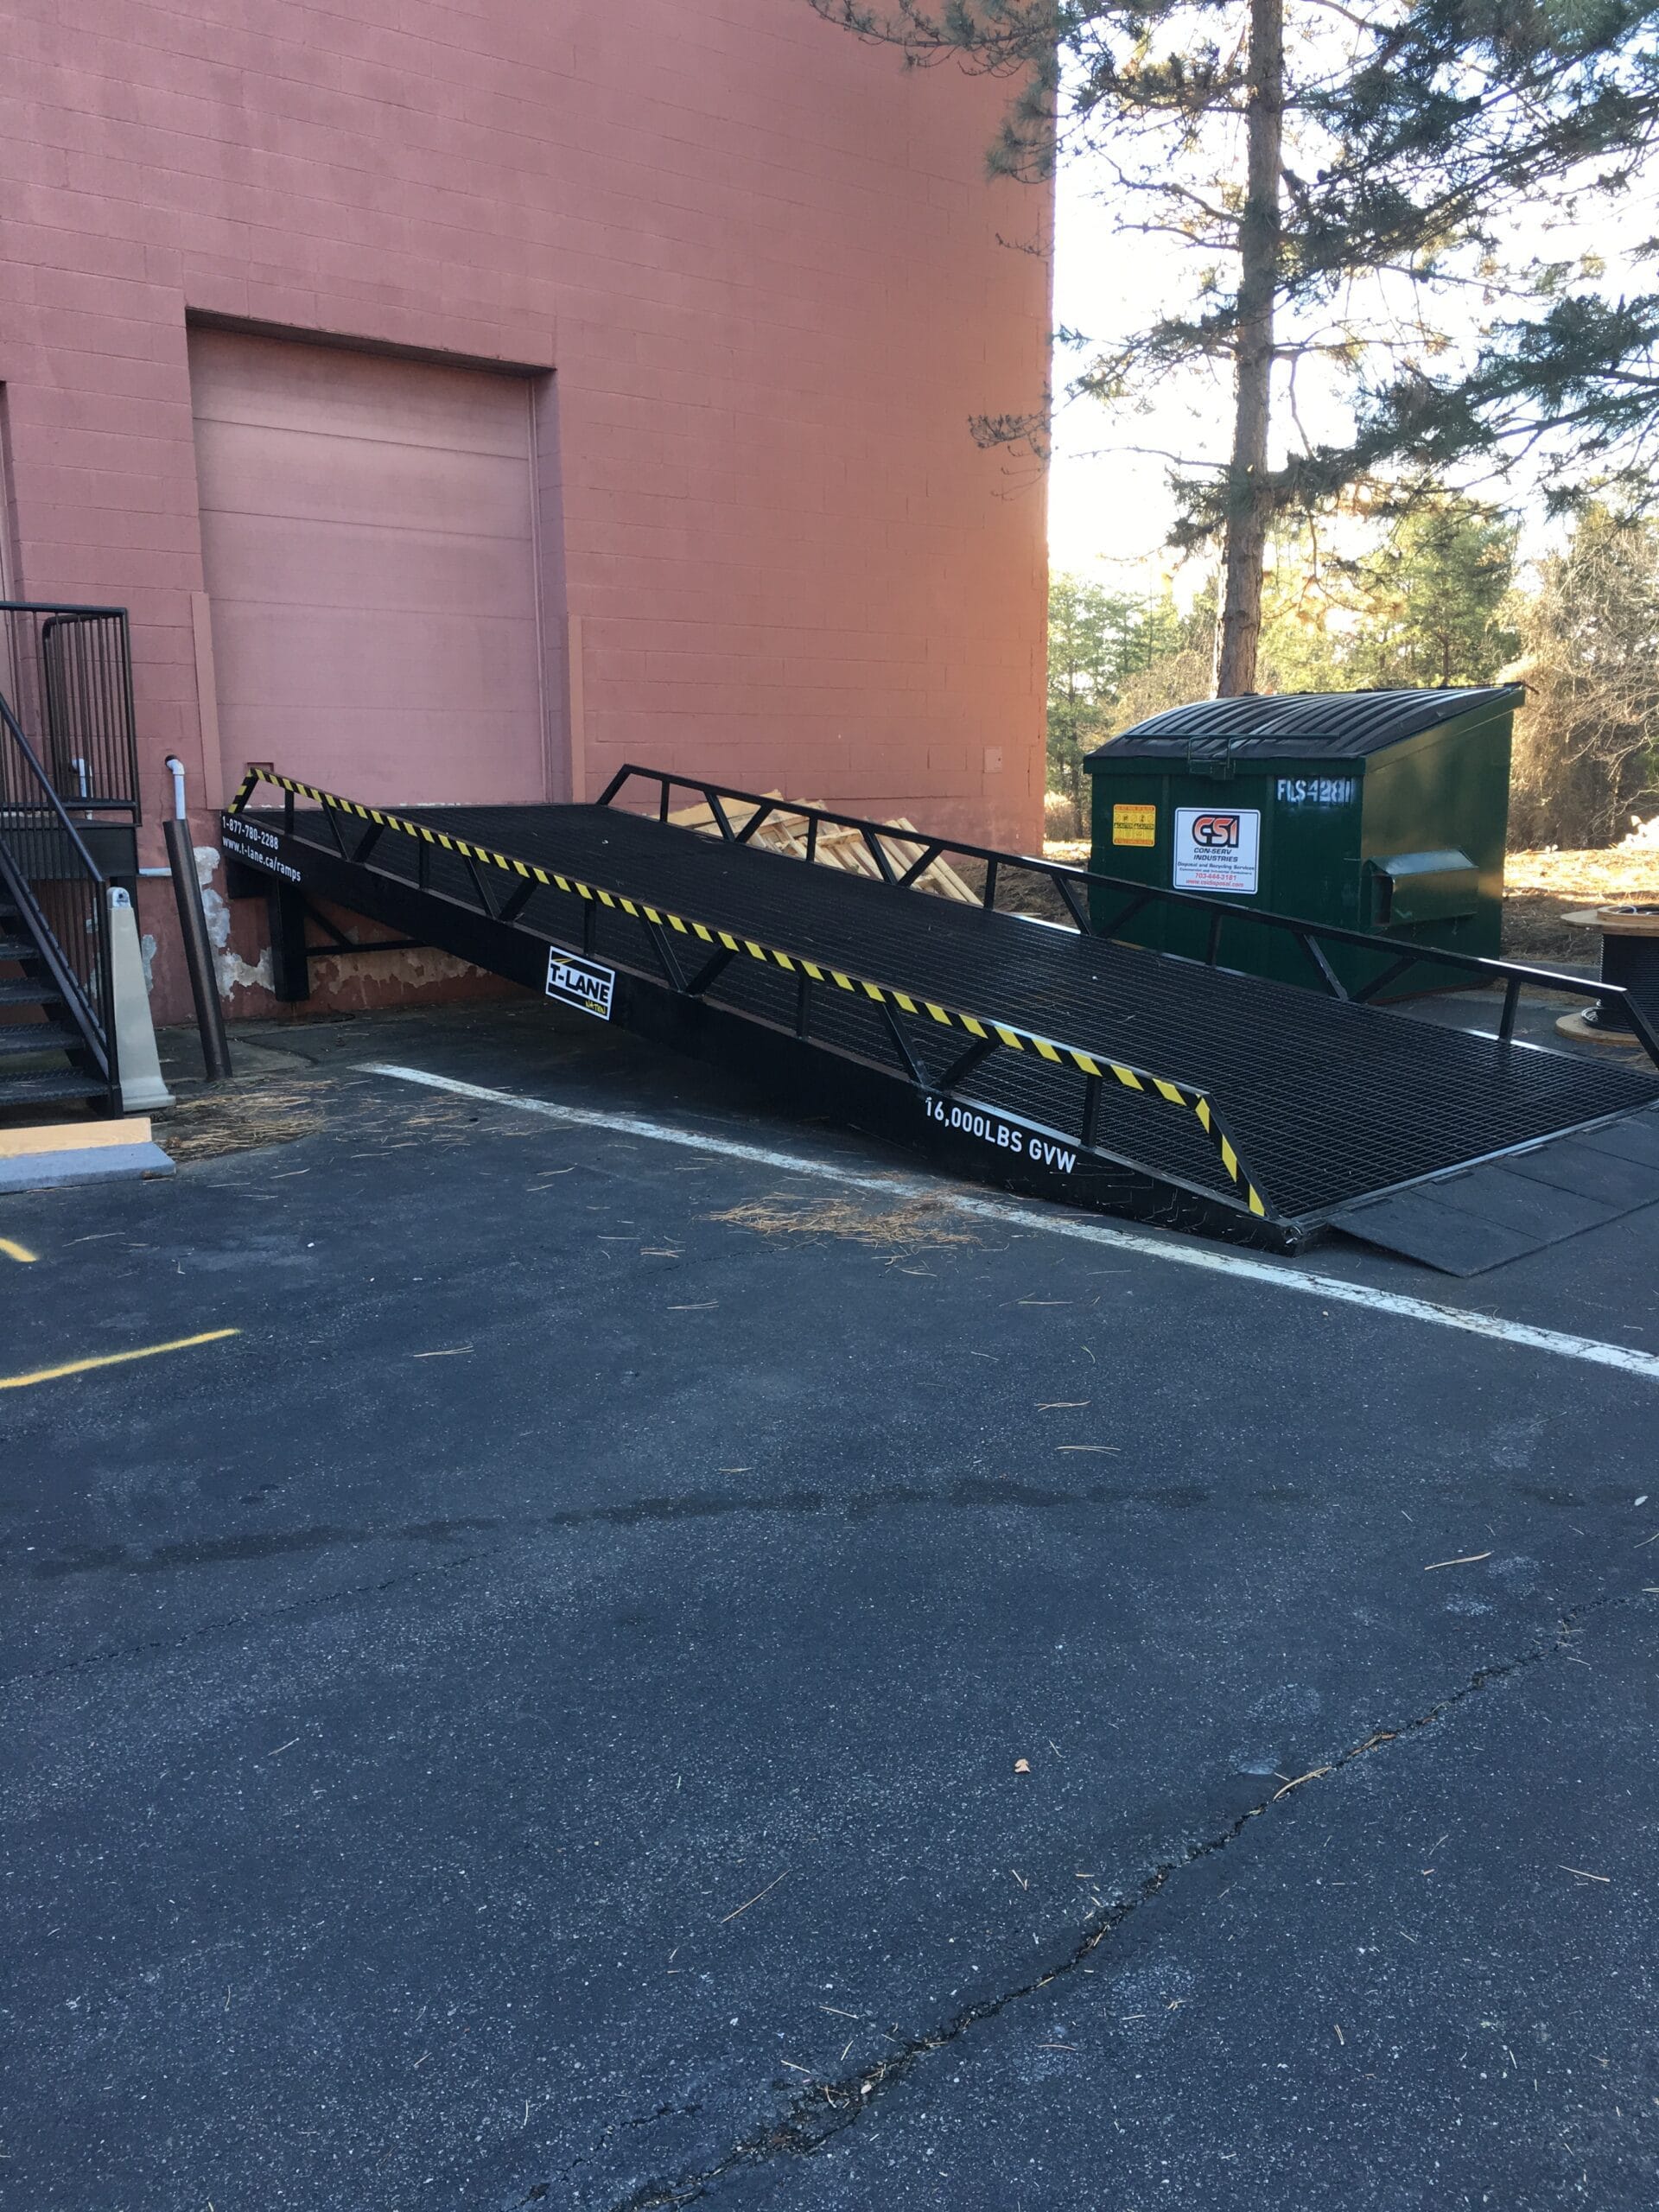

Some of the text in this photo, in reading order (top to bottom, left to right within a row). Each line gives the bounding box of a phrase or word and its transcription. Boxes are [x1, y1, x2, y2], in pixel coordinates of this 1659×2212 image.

[222, 816, 279, 850] 1-877-780-2288
[1192, 814, 1240, 849] CSI
[222, 836, 302, 882] www.t-lane.ca/ramps
[550, 963, 610, 1004] T-LANE
[925, 1096, 1077, 1174] 16,000LBS GVW
